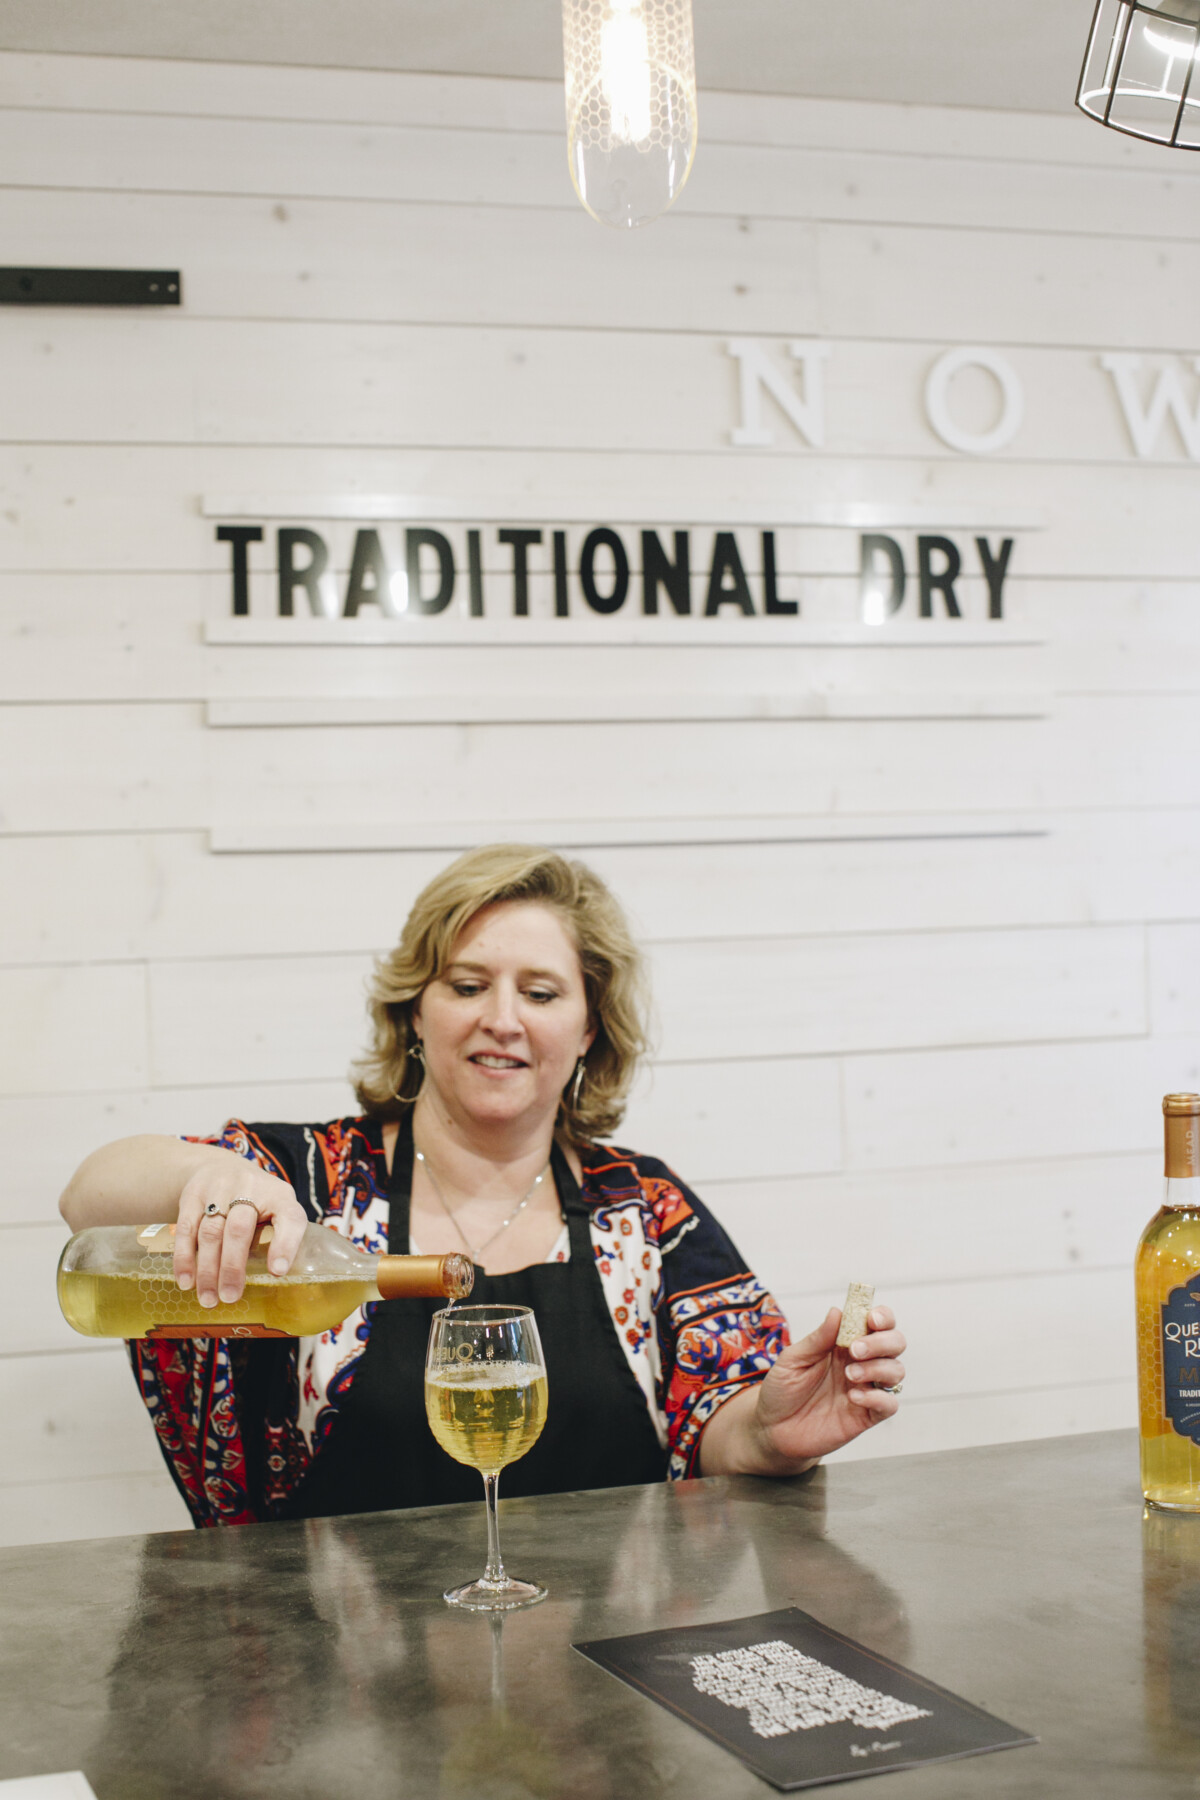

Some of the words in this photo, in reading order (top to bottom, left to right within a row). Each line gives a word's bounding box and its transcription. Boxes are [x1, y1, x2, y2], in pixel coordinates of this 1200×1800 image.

[723, 338, 1200, 458] NOW
[216, 526, 798, 617] TRADITIONAL
[860, 533, 1014, 619] DRY
[1185, 1338, 1200, 1358] R
